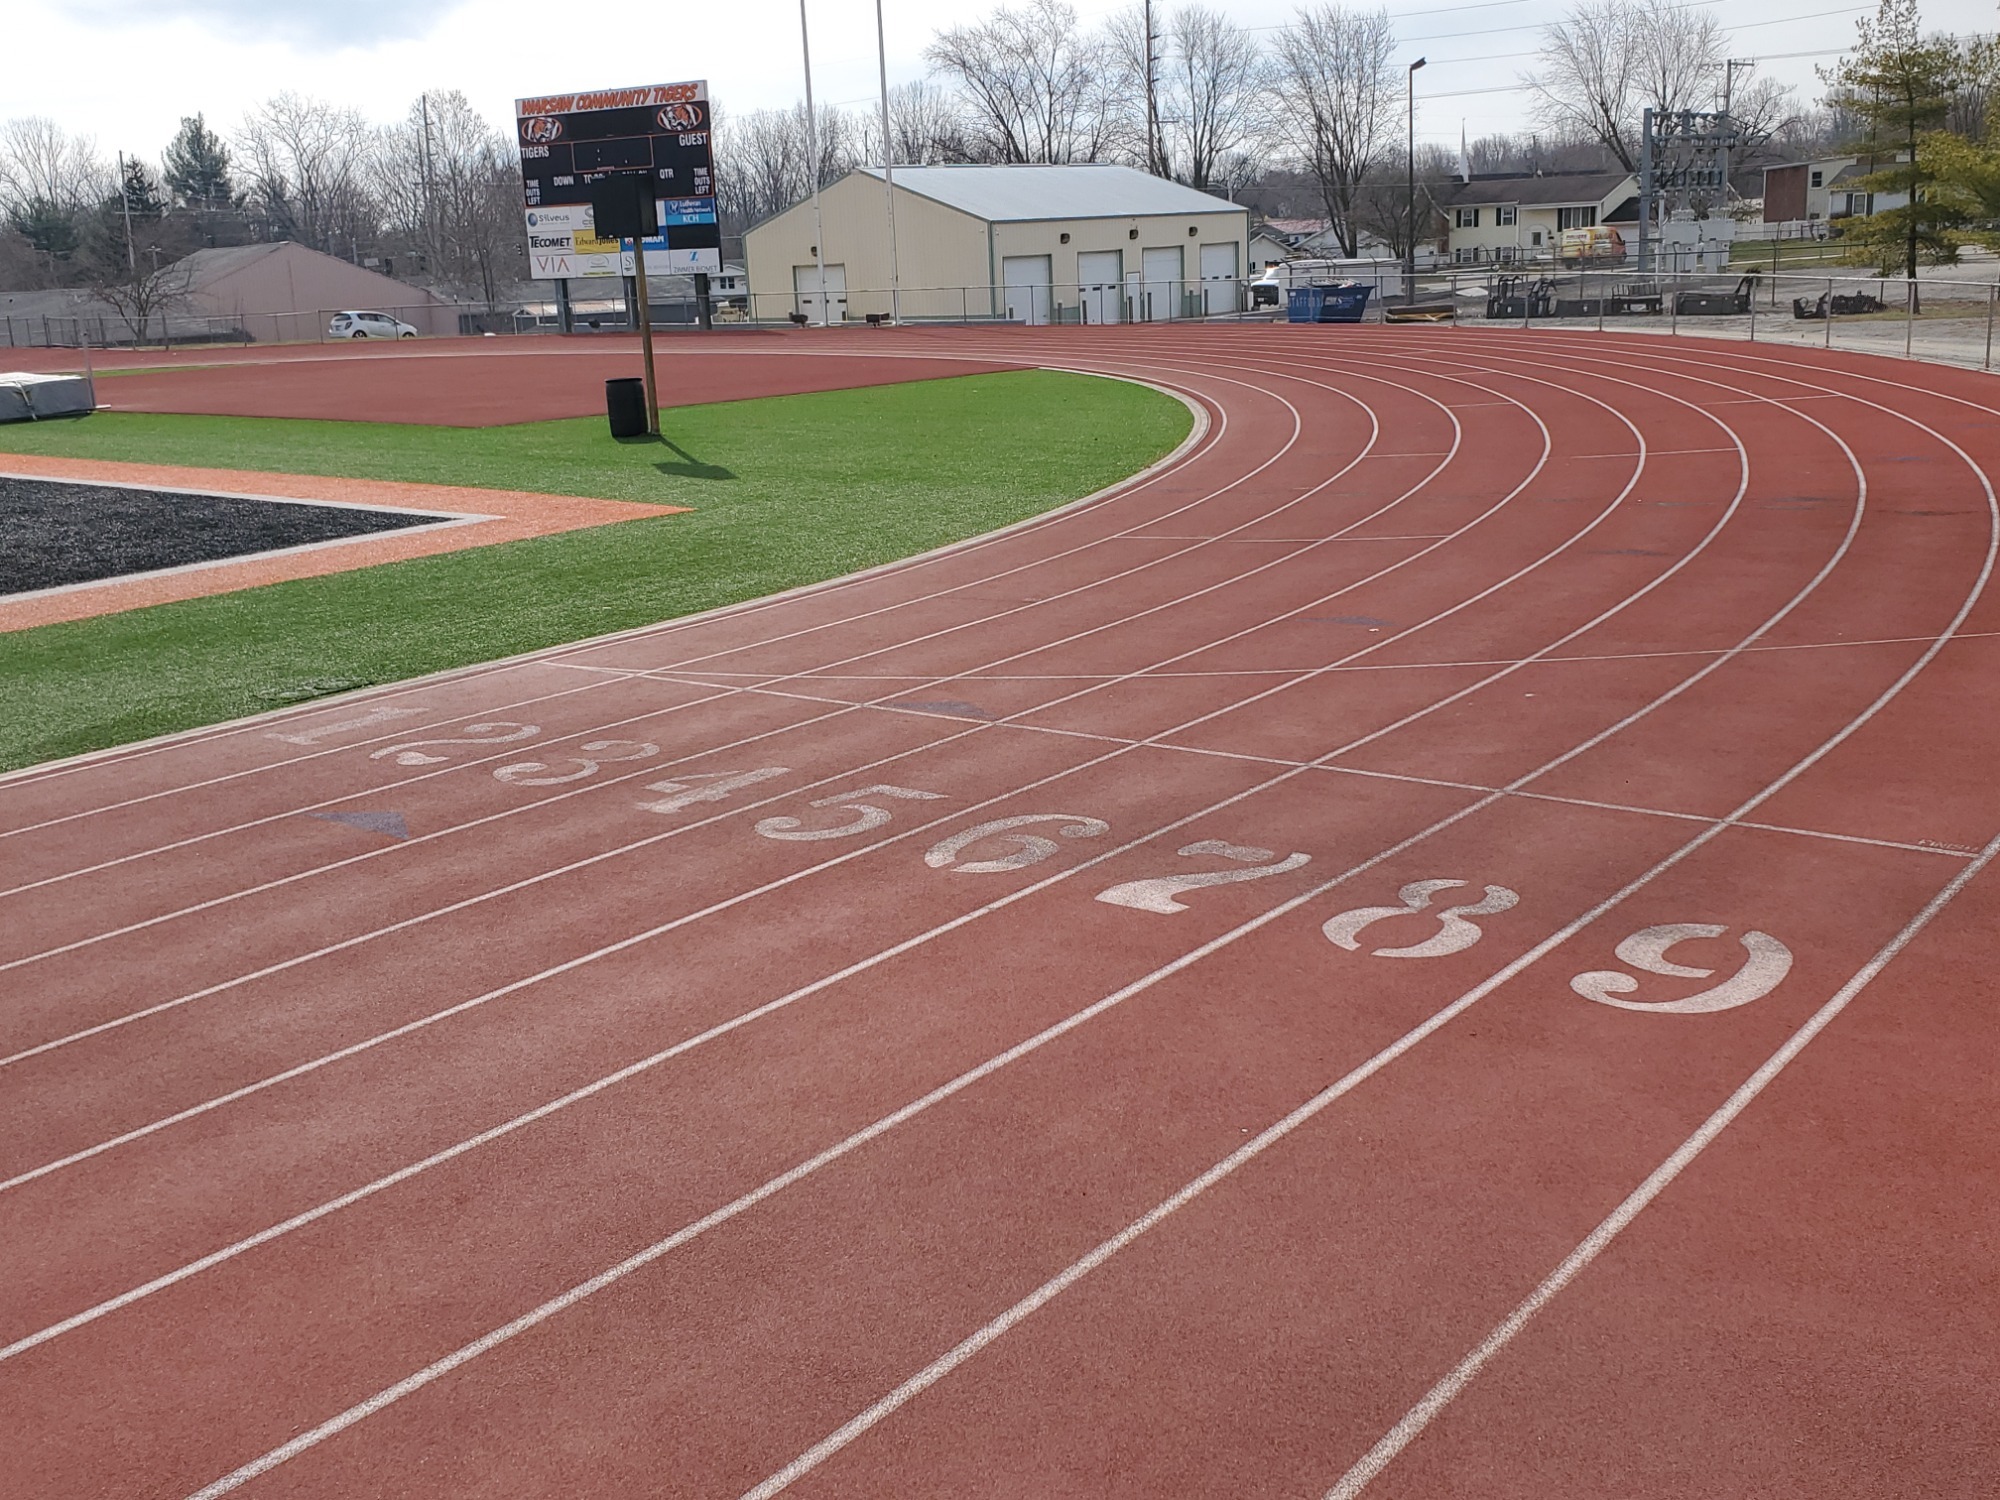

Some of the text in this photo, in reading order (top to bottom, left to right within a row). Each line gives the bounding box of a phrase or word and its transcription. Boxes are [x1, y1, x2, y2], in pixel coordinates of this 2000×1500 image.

[522, 83, 698, 115] WARSAW COMMUNITY TIGERS
[679, 132, 708, 147] GUEST
[521, 146, 549, 159] TIGERS
[659, 168, 675, 179] QTR
[694, 167, 708, 176] TIME
[526, 179, 540, 188] TIME
[553, 175, 575, 187] DOWN
[694, 176, 710, 186] OUTS
[526, 188, 541, 197] OUTS
[695, 186, 709, 195] LEFT
[527, 197, 541, 206] LEFT
[538, 213, 570, 222] Silveus
[682, 214, 700, 224] KCH
[529, 235, 571, 248] TECOMET
[536, 256, 570, 273] VIA
[263, 706, 430, 746] 1
[369, 721, 542, 766] 2
[493, 739, 660, 786] 3
[632, 766, 792, 814] 4
[754, 783, 951, 842] 5
[924, 813, 1109, 873] 6
[1094, 838, 1311, 915] 7
[1322, 878, 1520, 958] 8
[1570, 922, 1794, 1014] 9
